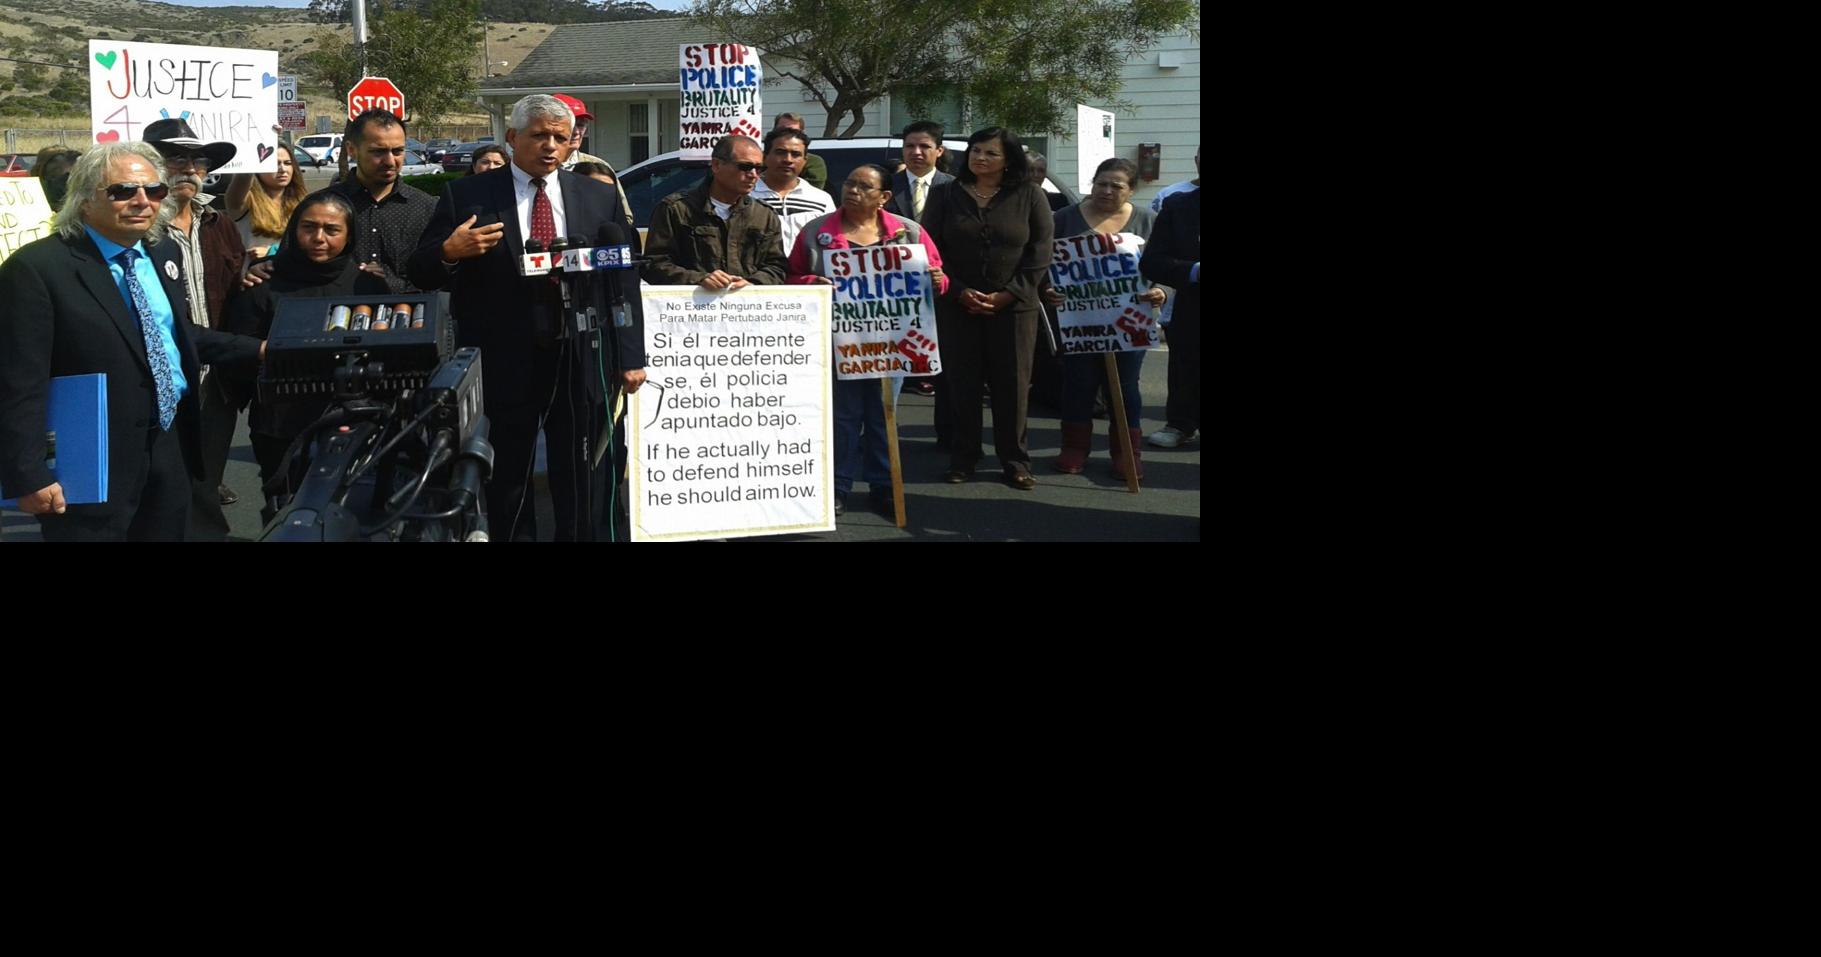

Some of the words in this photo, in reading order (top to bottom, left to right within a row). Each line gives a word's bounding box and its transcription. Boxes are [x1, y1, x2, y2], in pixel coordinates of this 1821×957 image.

[685, 43, 749, 67] STOP
[107, 48, 254, 101] JUSTICE
[681, 65, 756, 90] POLICE
[280, 89, 293, 101] 10
[681, 87, 757, 107] BRUTALITY
[352, 95, 400, 117] STOP
[681, 106, 740, 118] JUSTICE
[747, 105, 755, 115] 4
[103, 105, 142, 144] 4
[680, 137, 718, 149] GARC
[608, 248, 620, 260] 5
[1053, 232, 1124, 262] STOP
[564, 254, 579, 267] 14
[831, 246, 913, 276] STOP
[1049, 253, 1138, 284] POLICE
[832, 271, 921, 301] POLICE
[666, 302, 681, 311] No
[684, 302, 716, 311] Existe
[720, 302, 762, 313] Ninguna
[765, 301, 802, 310] Excusa
[832, 297, 922, 321] BRUTALITY
[1058, 296, 1121, 313] JUSTICE
[1130, 294, 1139, 305] 4
[659, 314, 684, 323] Para
[688, 314, 717, 323] Matar
[721, 313, 773, 322] Pertubado
[776, 313, 806, 322] Janira
[832, 318, 901, 333] JUSTICE
[910, 317, 921, 329] 4
[653, 333, 672, 349] Si
[683, 333, 699, 348] él
[709, 332, 805, 348] realmente
[1064, 340, 1123, 353] GARCIA
[646, 351, 691, 368] tenia
[694, 354, 728, 370] que
[730, 350, 811, 366] defender
[838, 357, 903, 375] GARCIA
[664, 376, 692, 390] se,
[700, 372, 716, 388] él
[727, 370, 787, 390] policia
[667, 393, 720, 409] debio
[730, 392, 785, 408] haber
[661, 412, 753, 433] apuntado
[758, 410, 801, 429] bajo.
[647, 443, 664, 460] If
[666, 443, 690, 460] he
[697, 440, 770, 459] actually
[777, 438, 811, 455] had
[647, 467, 665, 482] to
[672, 462, 739, 481] defend
[747, 459, 814, 478] himself
[648, 489, 672, 506] he
[677, 485, 741, 505] should
[745, 484, 779, 501] aim
[783, 483, 816, 499] low.
